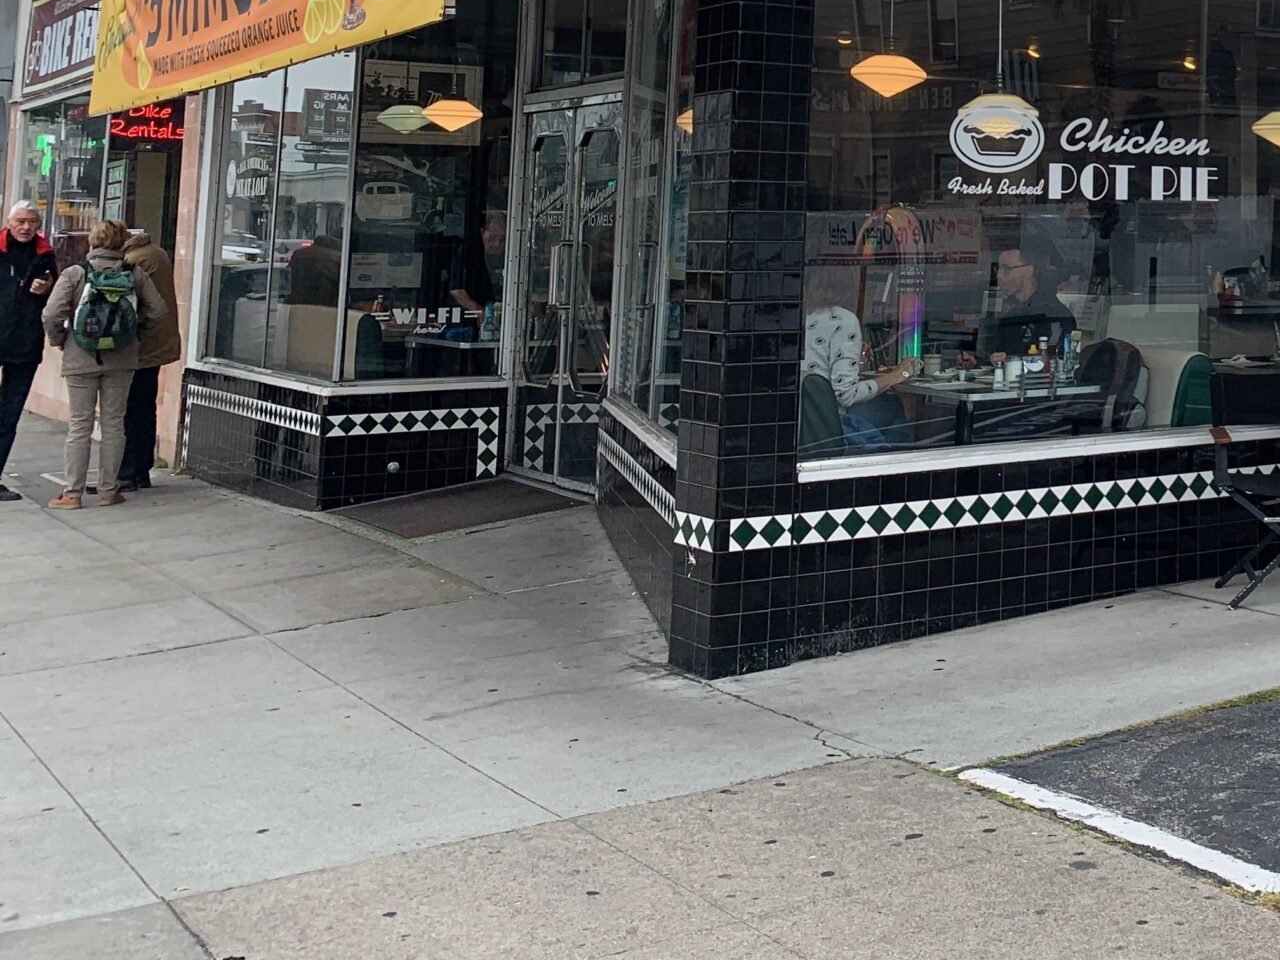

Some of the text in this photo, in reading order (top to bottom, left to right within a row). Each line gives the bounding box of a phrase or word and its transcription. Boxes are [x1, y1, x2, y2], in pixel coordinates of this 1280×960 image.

[39, 15, 73, 77] BIKE
[153, 8, 301, 75] MADE WITH FRESH SQUEEZED ORANGE JUICE
[111, 119, 186, 140] Rentals
[1059, 117, 1211, 157] Chicken
[947, 177, 1044, 195] Fresh Baked
[1048, 162, 1219, 203] POT PIE
[391, 306, 462, 325] WI-FI
[413, 324, 447, 335] here!
